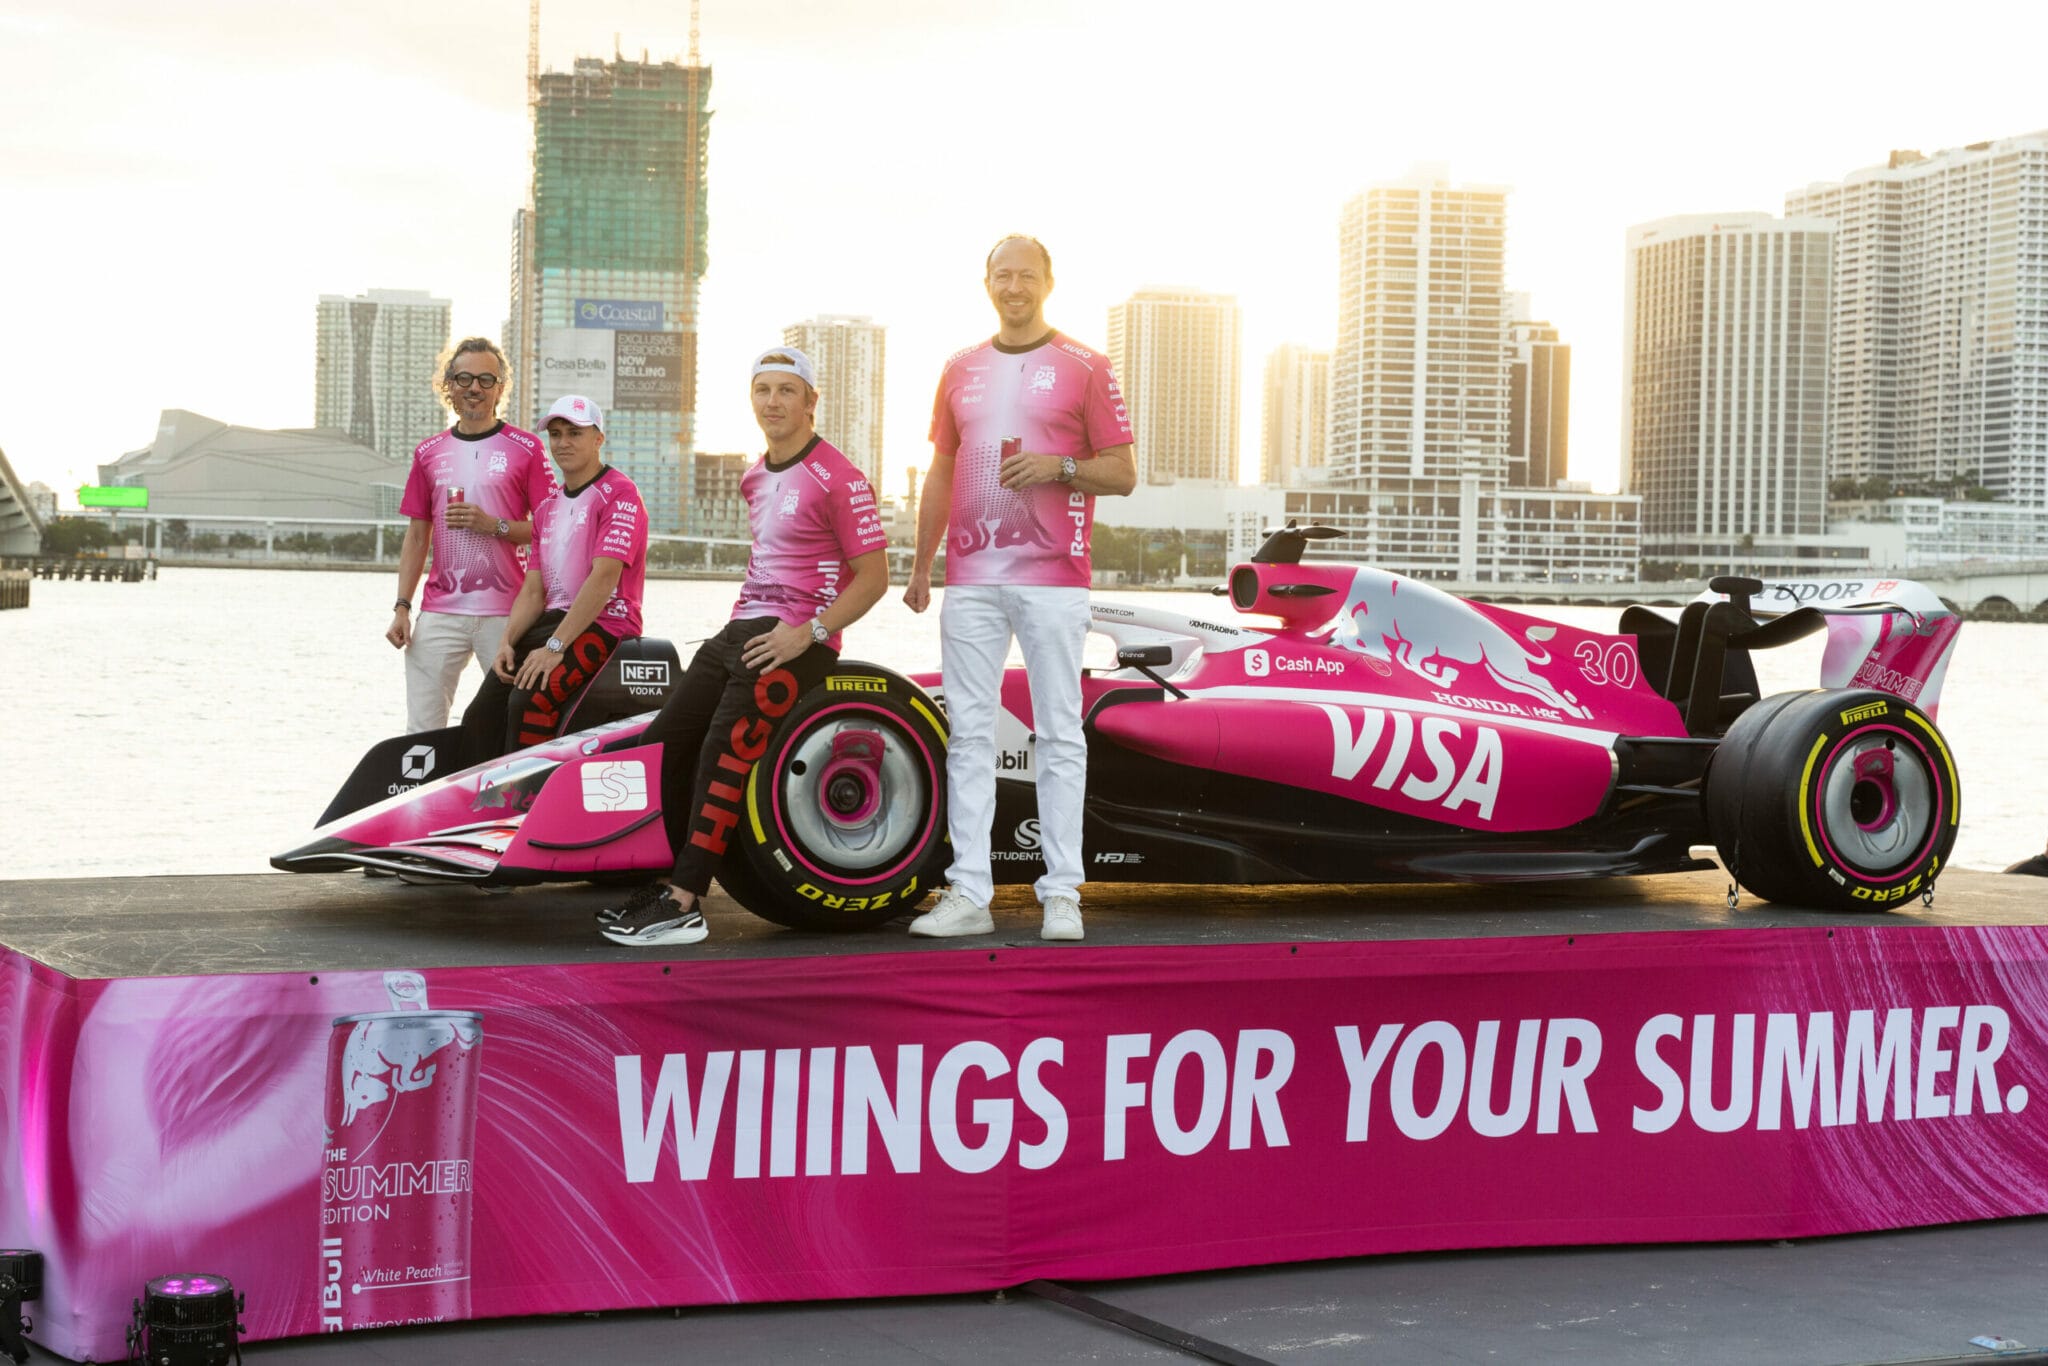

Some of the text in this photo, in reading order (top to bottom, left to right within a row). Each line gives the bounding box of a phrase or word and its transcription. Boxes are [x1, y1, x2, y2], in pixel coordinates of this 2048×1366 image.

[599, 304, 656, 321] Coastal
[618, 334, 675, 346] EXCLUSIVE
[618, 356, 646, 366] NOW
[1062, 343, 1092, 359] HUGO
[544, 357, 606, 370] Casa Bella
[617, 366, 666, 378] SELLING
[509, 432, 535, 448] HUGO
[811, 461, 831, 480] HUGO
[615, 501, 638, 514] VISA
[1068, 511, 1085, 556] Red
[1752, 583, 1863, 600] TUDOR
[626, 665, 664, 680] NEFT
[1275, 656, 1313, 671] Cash
[1315, 657, 1345, 676] App
[1574, 640, 1638, 689] 30
[629, 687, 663, 696] VODKA
[826, 675, 888, 693] PIRELLI
[1431, 691, 1563, 721] HONDA HRC
[1839, 700, 1889, 726] PIRELLI
[690, 668, 798, 856] HUGO
[995, 750, 1028, 770] bil
[1298, 701, 1504, 821] VISA
[991, 851, 1045, 862] STUDENT.
[1928, 855, 1939, 878] P
[796, 875, 918, 911] P ZERO
[1852, 875, 1922, 902] ZERO
[614, 1004, 2029, 1183] WIIINGS FOR YOUR SUMMER.
[325, 1148, 347, 1163] THE
[323, 1159, 472, 1204] SUMMER
[323, 1203, 390, 1225] EDITION
[322, 1238, 343, 1309] Bull
[362, 1268, 401, 1284] White
[405, 1264, 442, 1280] Peach
